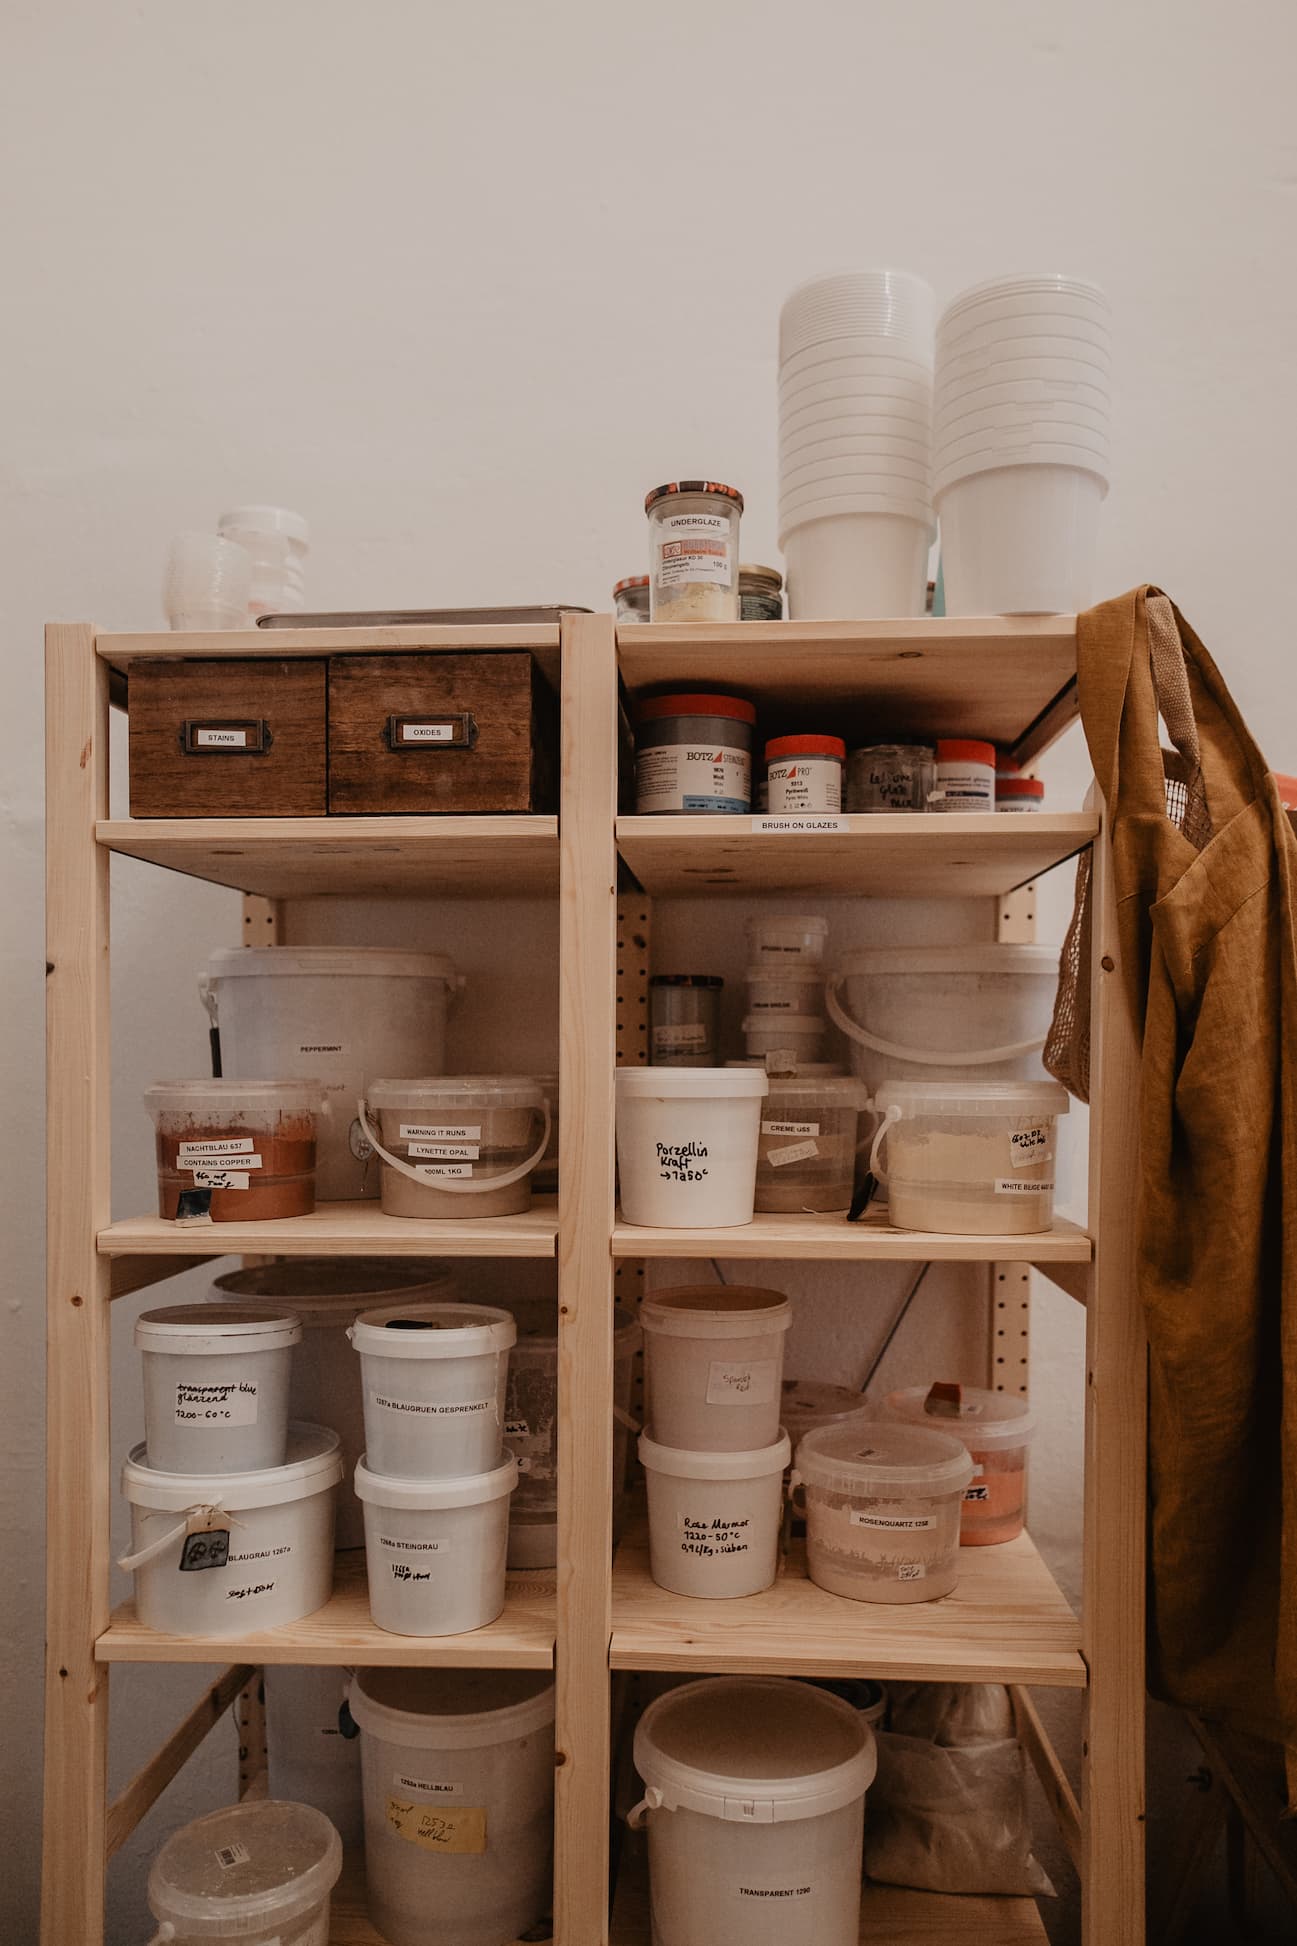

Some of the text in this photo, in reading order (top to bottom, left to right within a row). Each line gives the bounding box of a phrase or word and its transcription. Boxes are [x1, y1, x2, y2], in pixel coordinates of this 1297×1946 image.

[671, 518, 721, 528] UNDERGLAZE
[208, 734, 235, 742] STAINS
[686, 751, 714, 761] BOTZ
[300, 1045, 342, 1053] PEPPERMINT
[186, 1144, 228, 1152] NACHTBLAU
[416, 1147, 447, 1155] LYNETTE
[239, 1381, 257, 1395] blue
[391, 1402, 437, 1414] BLAUGRUEN
[439, 1402, 489, 1413] GESPRENKELT
[859, 1516, 913, 1528] ROSENQUARTZ
[396, 1542, 439, 1550] STEINGRAU
[228, 1546, 291, 1562] BLAUGRAU 1267a
[417, 1783, 454, 1792] HELLBLAU
[739, 1888, 794, 1896] TRANSPARENT
